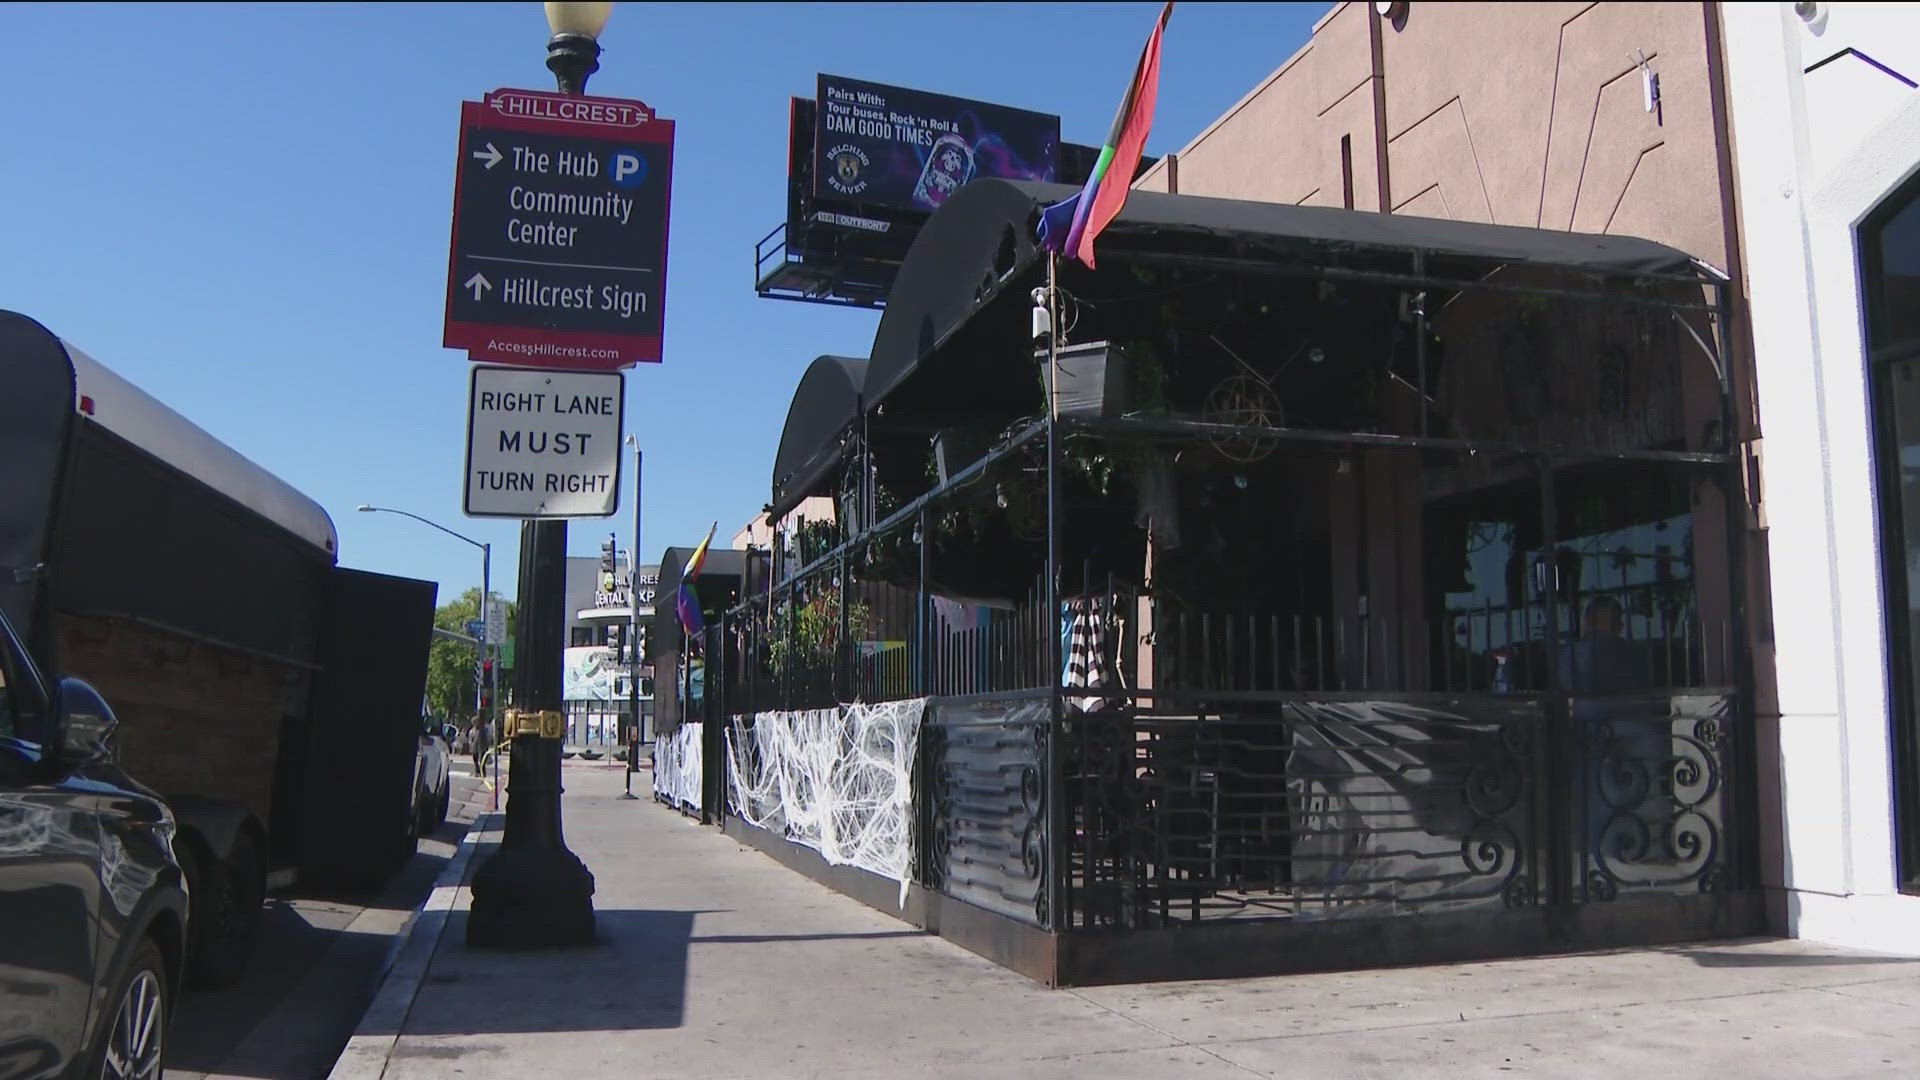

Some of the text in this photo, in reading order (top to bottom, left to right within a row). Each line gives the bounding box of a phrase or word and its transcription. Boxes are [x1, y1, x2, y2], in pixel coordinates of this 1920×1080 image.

[827, 87, 885, 106] Pairs With:
[508, 97, 632, 123] HILLCREST
[827, 101, 851, 115] Tour
[853, 105, 887, 122] buses,
[890, 112, 915, 126] Rock
[930, 119, 949, 131] Roll
[951, 122, 959, 133] &
[827, 114, 932, 146] DAM GOOD TIMES
[513, 147, 639, 182] The Hub P
[826, 144, 870, 166] BELCHING
[828, 175, 868, 194] BEAVER
[510, 186, 633, 224] Community
[508, 219, 577, 246] Center
[503, 278, 647, 318] Hillcrest Sign
[488, 339, 619, 359] AccessHillcrest.com
[481, 392, 613, 415] RIGHT LANE
[500, 430, 592, 455] MUST
[477, 471, 609, 493] TURN RIGHT
[595, 590, 625, 606] DENTAL
